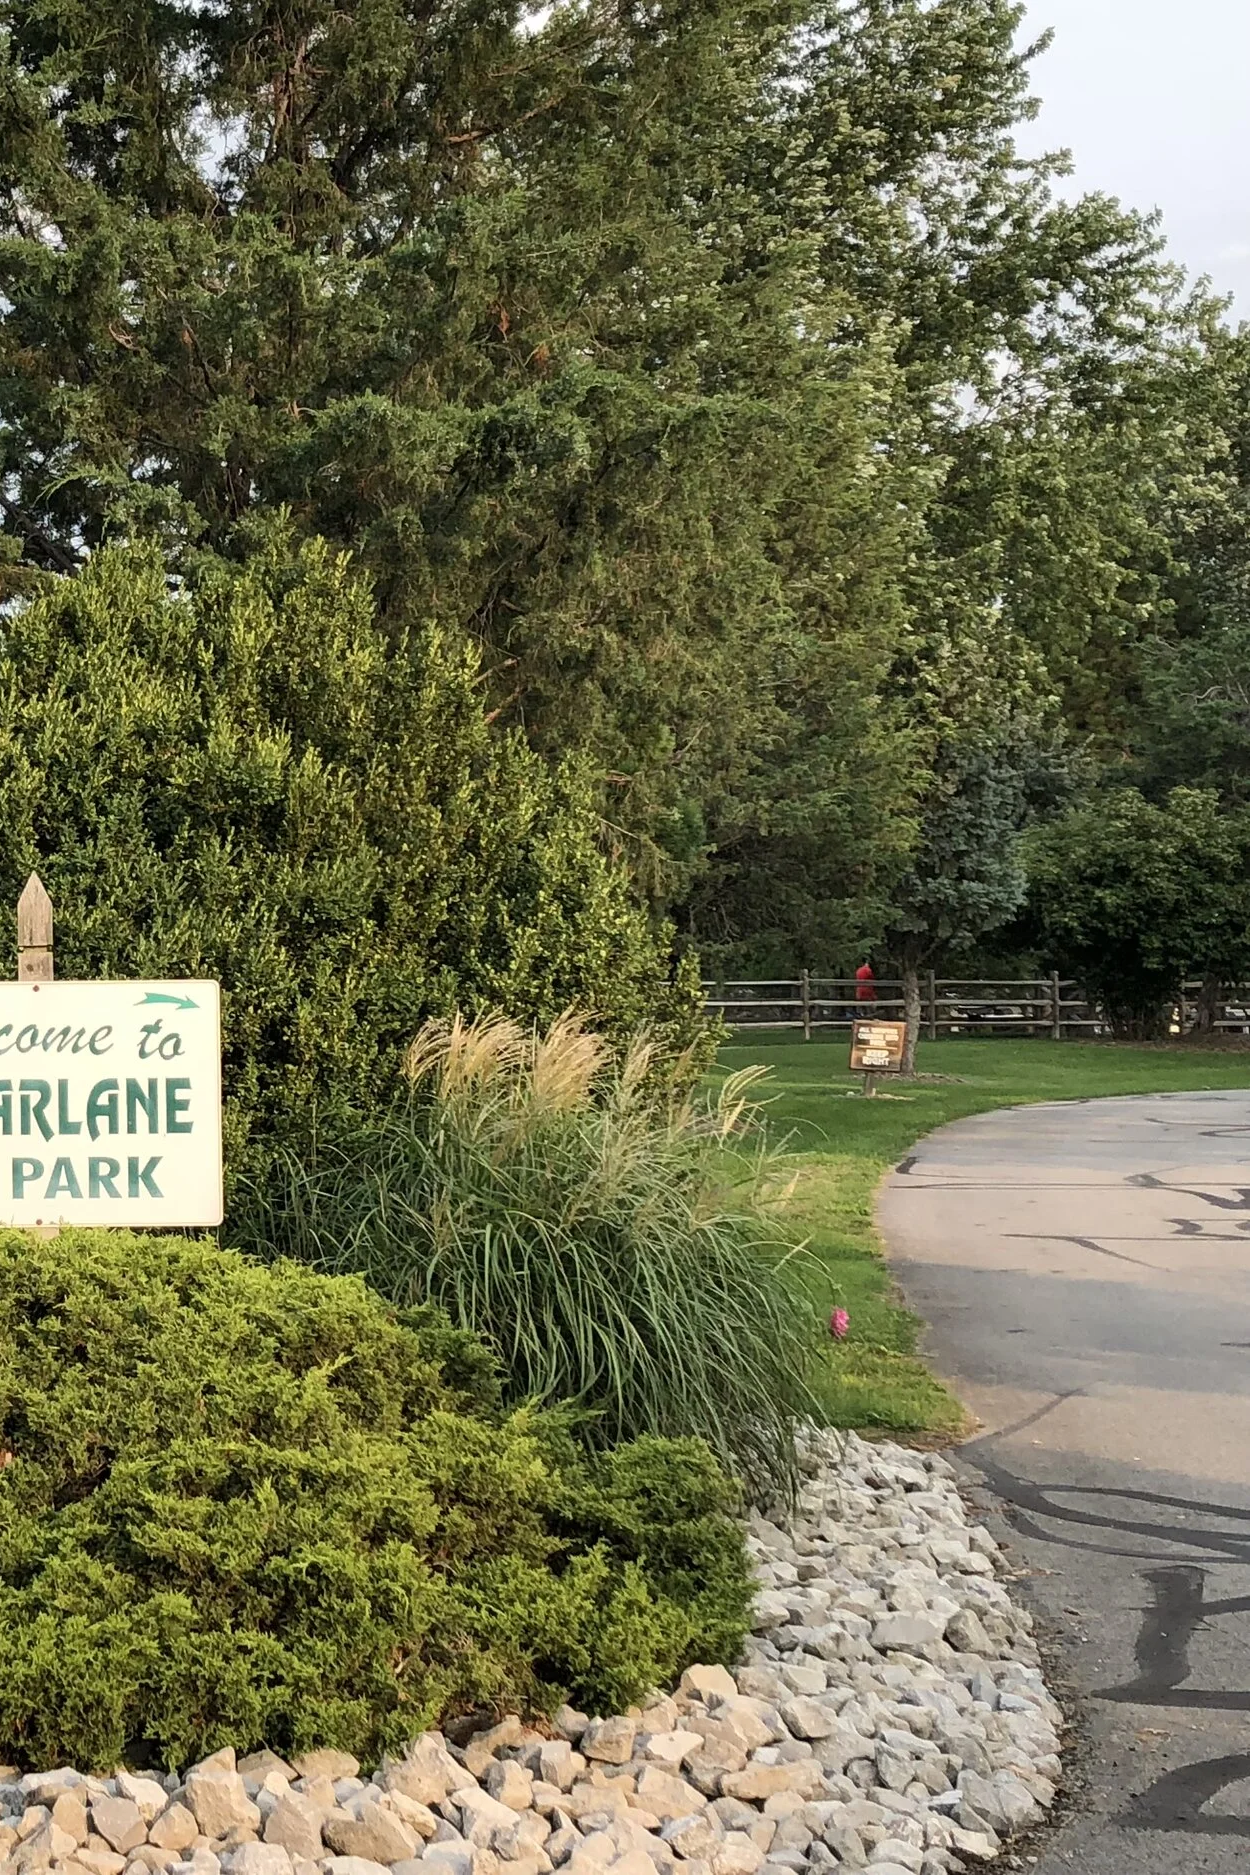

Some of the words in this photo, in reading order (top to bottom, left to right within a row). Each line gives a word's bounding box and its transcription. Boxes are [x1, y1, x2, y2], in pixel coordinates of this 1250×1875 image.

[135, 1018, 186, 1061] to
[862, 1056, 890, 1066] RIGHT
[11, 1156, 165, 1199] PARK
